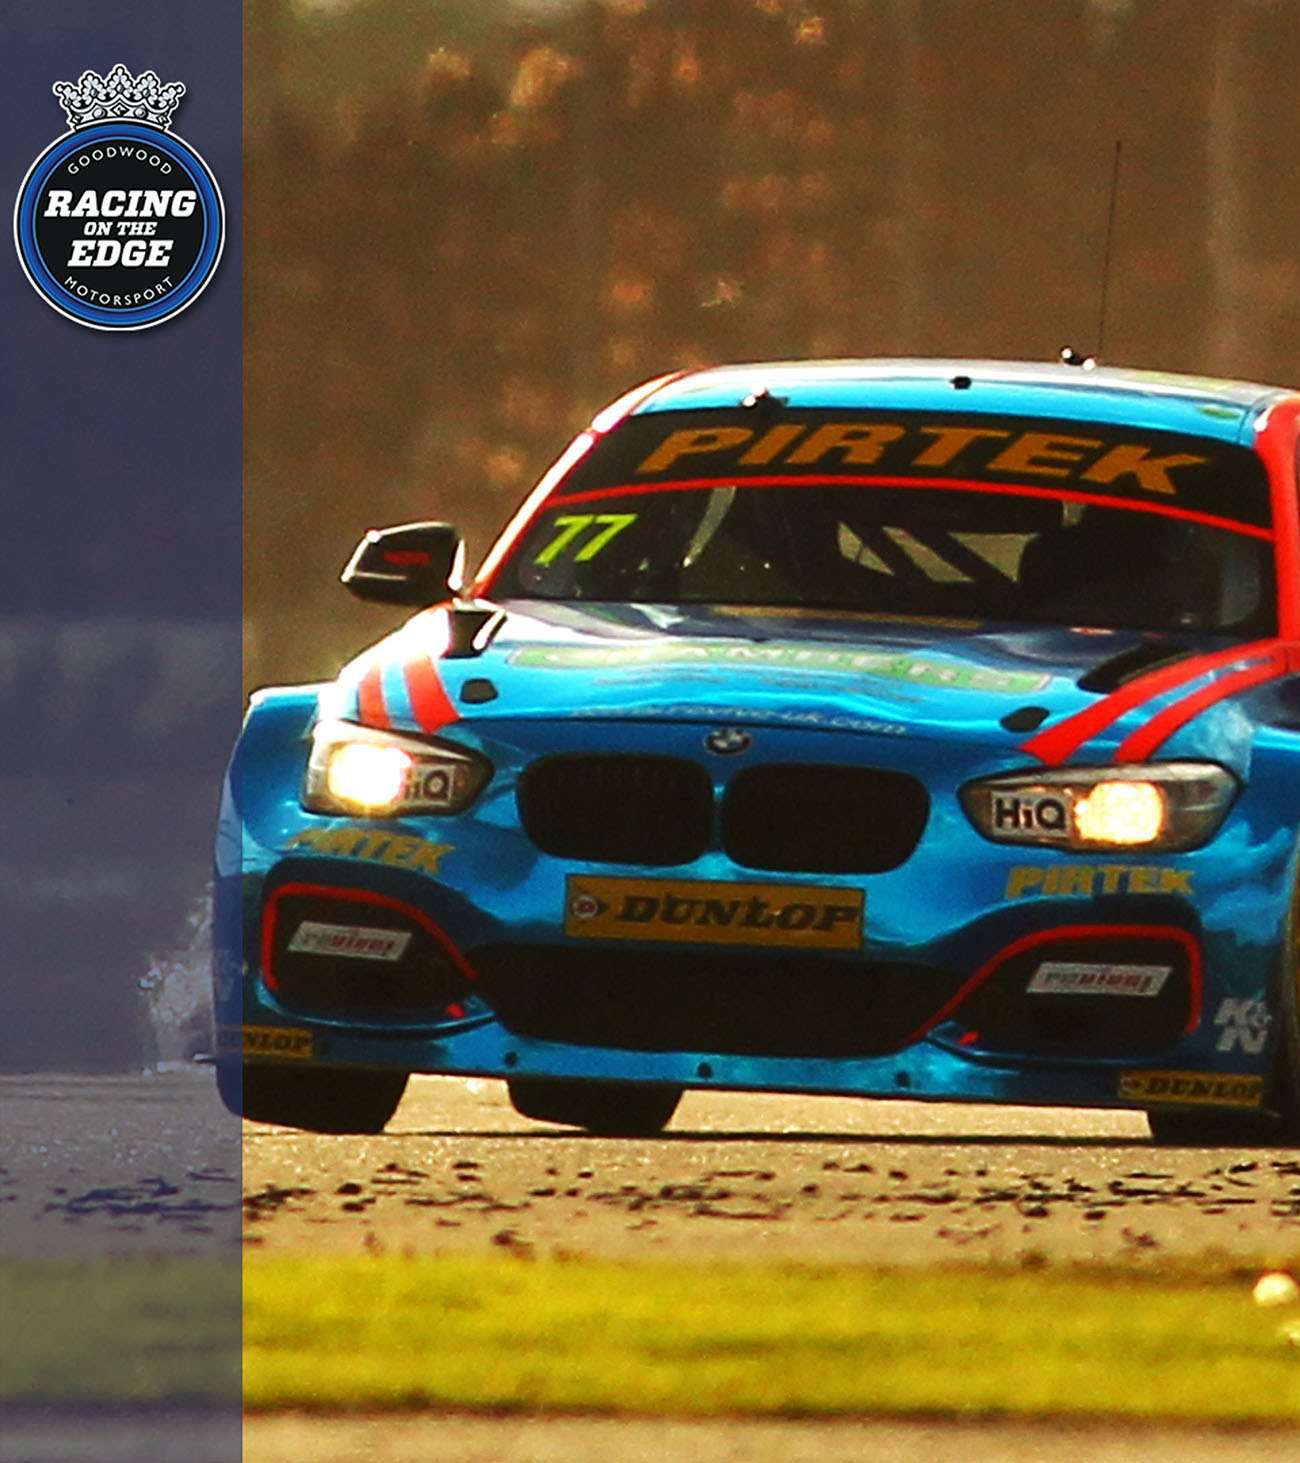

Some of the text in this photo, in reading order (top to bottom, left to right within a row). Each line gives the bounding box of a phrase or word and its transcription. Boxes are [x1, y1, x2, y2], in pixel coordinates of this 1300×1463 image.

[635, 424, 1211, 496] PIRTEK
[533, 512, 638, 565] 77
[995, 797, 1066, 829] HiQ
[1004, 864, 1195, 899] PIRTEK
[614, 891, 861, 931] DUNLOP
